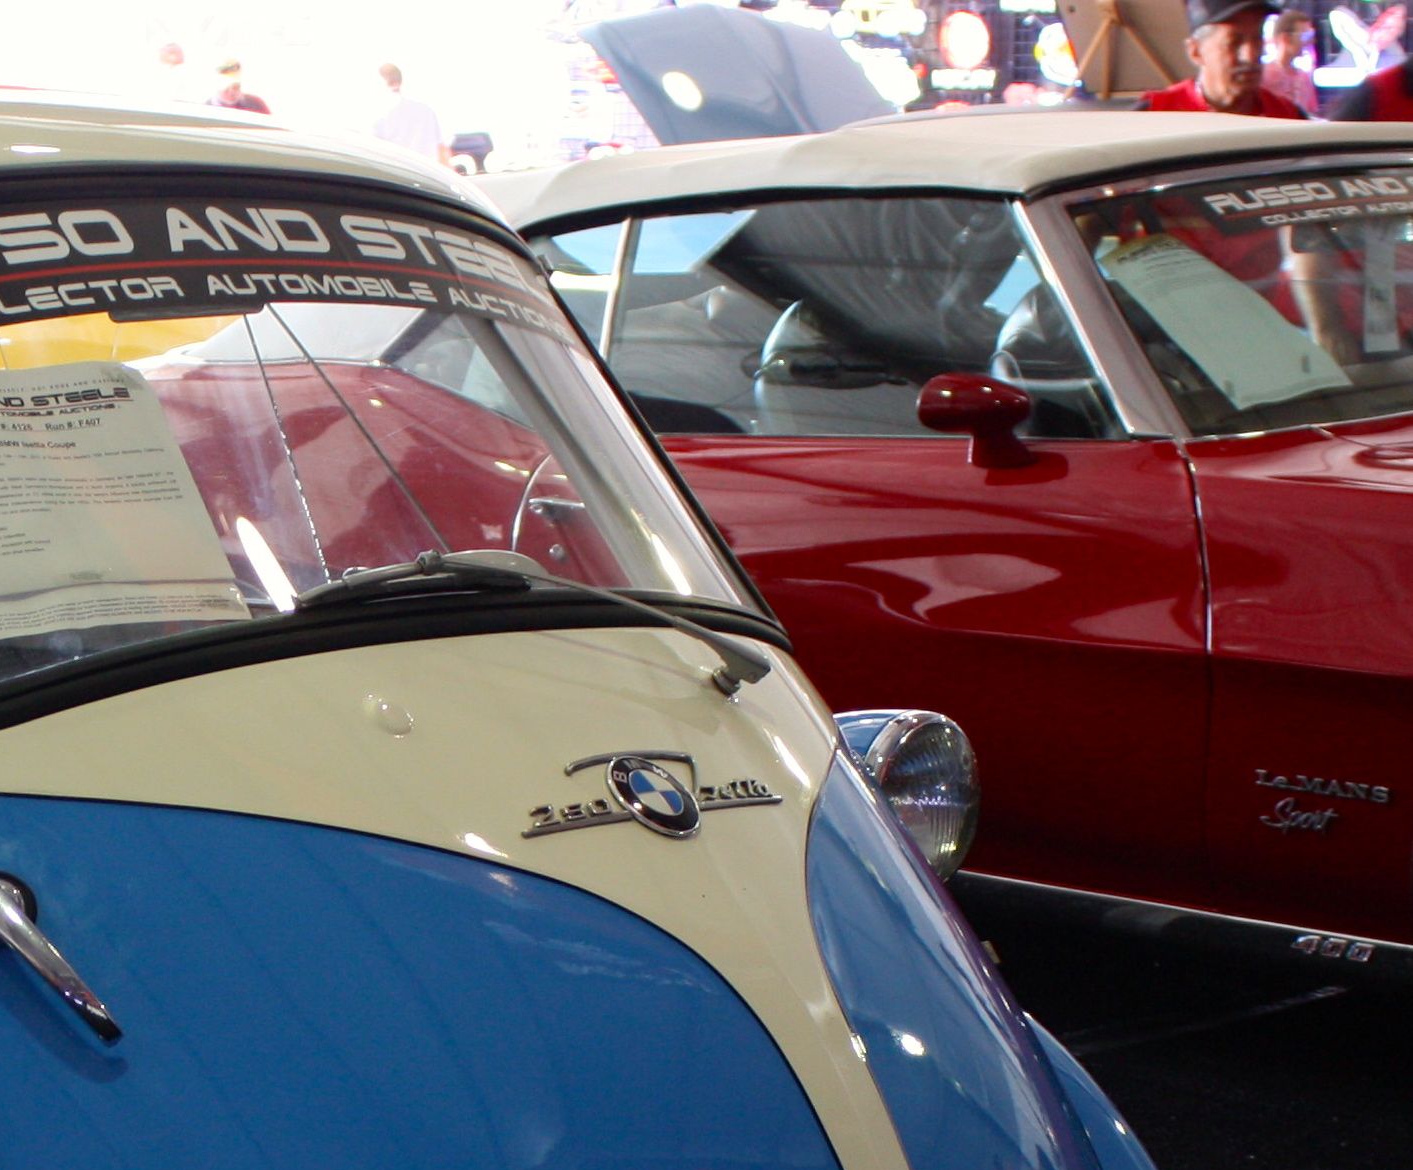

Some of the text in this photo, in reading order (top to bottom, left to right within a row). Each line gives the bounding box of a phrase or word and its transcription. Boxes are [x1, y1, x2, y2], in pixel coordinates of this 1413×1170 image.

[1203, 181, 1336, 216] RUSSO
[1340, 176, 1409, 198] AND
[1260, 204, 1362, 226] COLLECTOR
[164, 205, 332, 254] AND
[207, 272, 439, 304] AUTOMOBILE
[30, 386, 131, 407] STEELE
[44, 421, 65, 432] Run
[46, 440, 77, 450] Coupe
[1258, 796, 1339, 835] Sport
